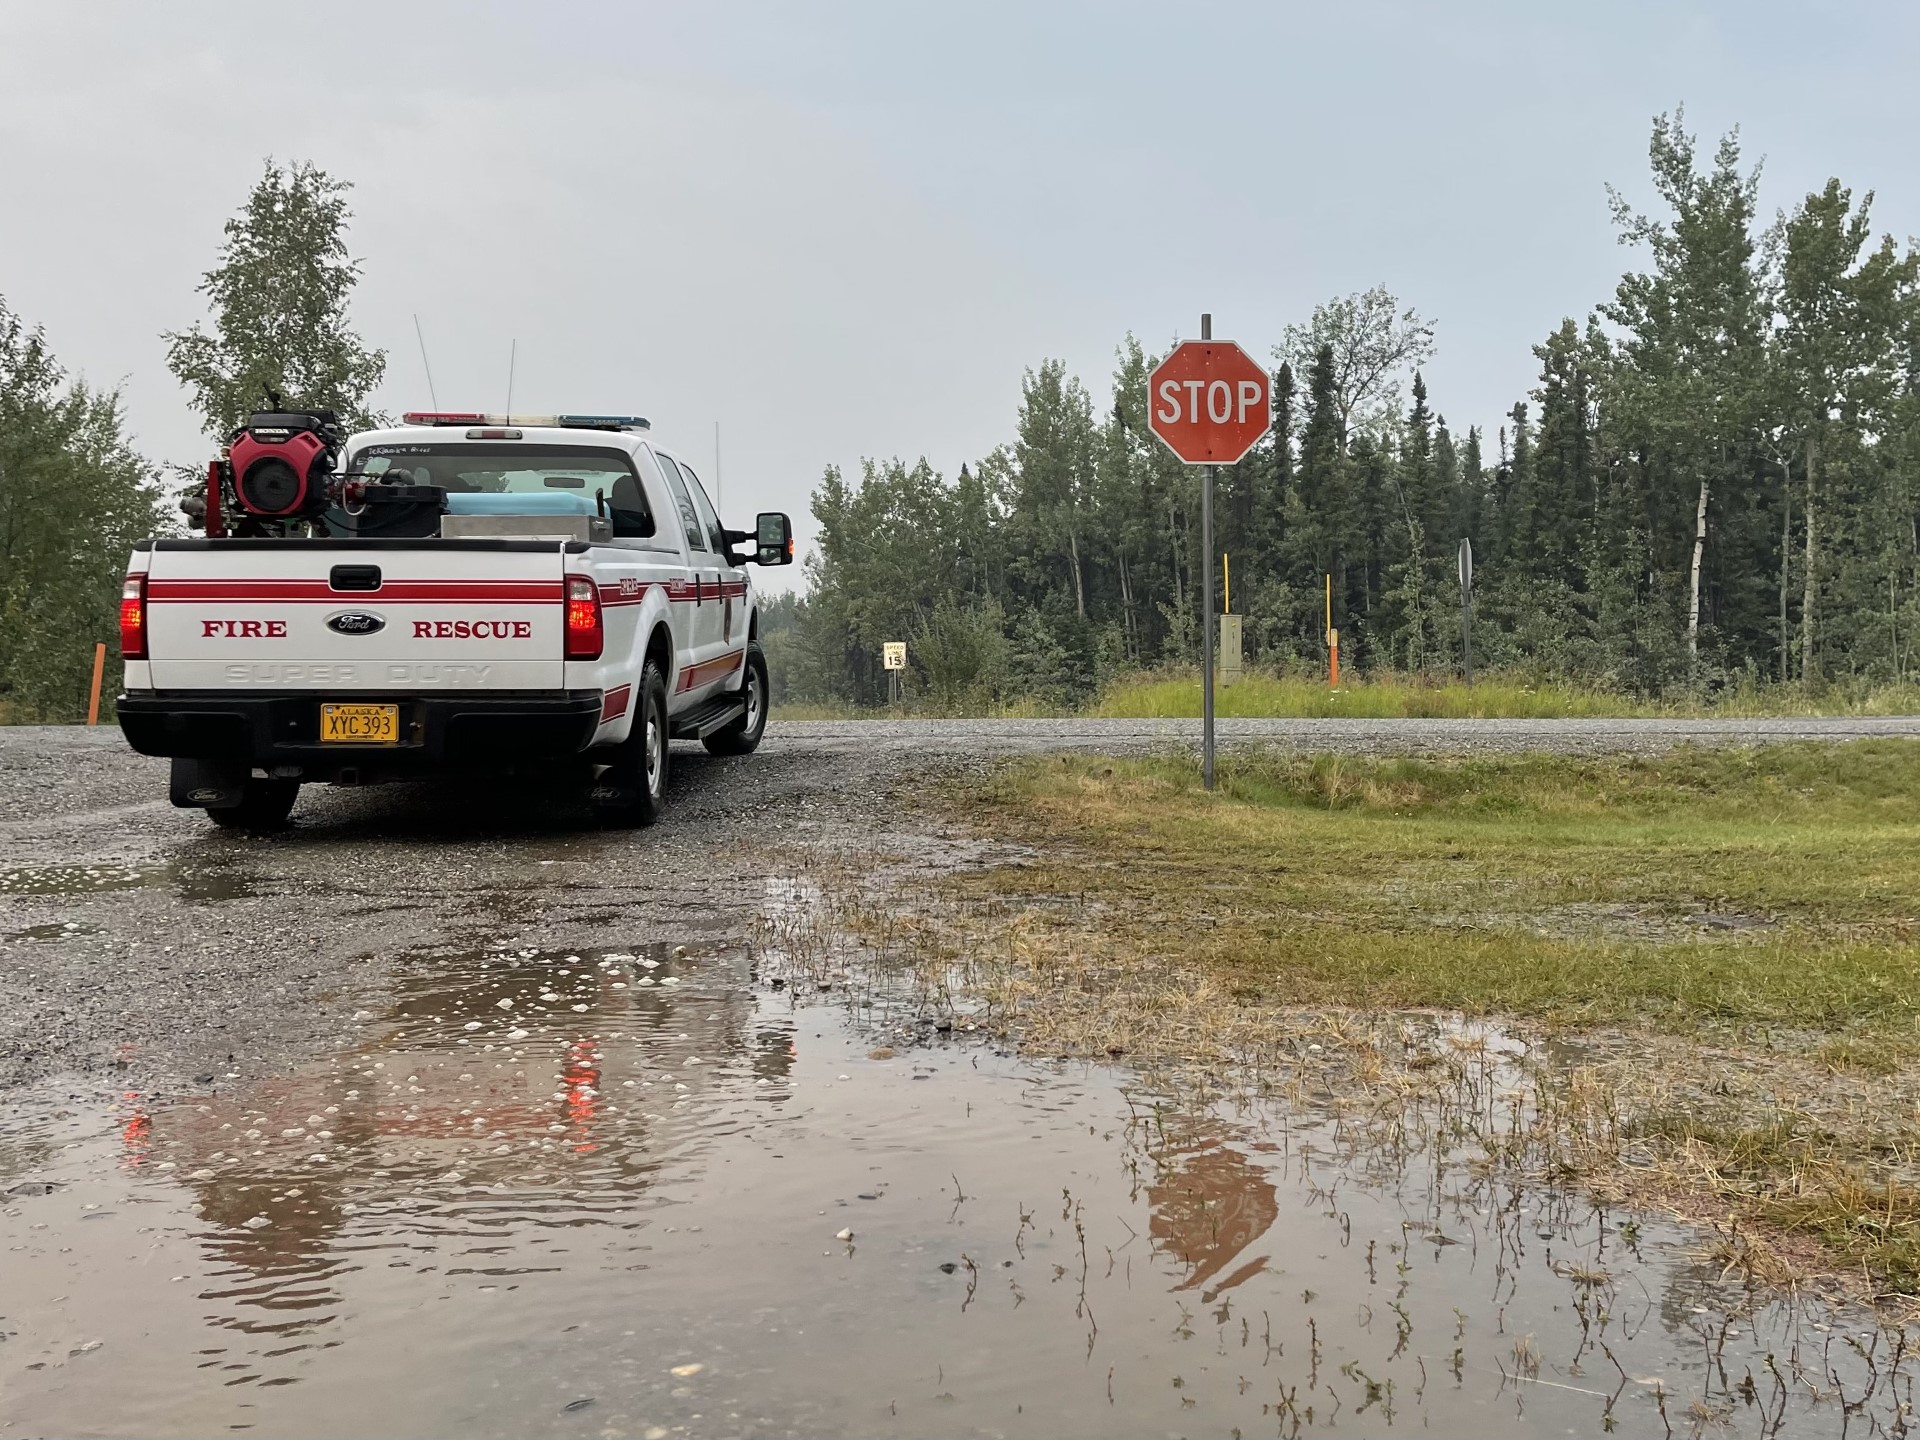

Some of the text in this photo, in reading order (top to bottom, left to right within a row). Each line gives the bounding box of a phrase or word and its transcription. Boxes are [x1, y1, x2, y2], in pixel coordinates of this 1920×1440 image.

[1157, 380, 1262, 424] STOP
[201, 620, 531, 639] FIRE RESCUE
[338, 615, 370, 630] Ford
[888, 656, 901, 666] 15
[225, 664, 491, 683] SUPER DUTY
[341, 708, 380, 716] ALASKA
